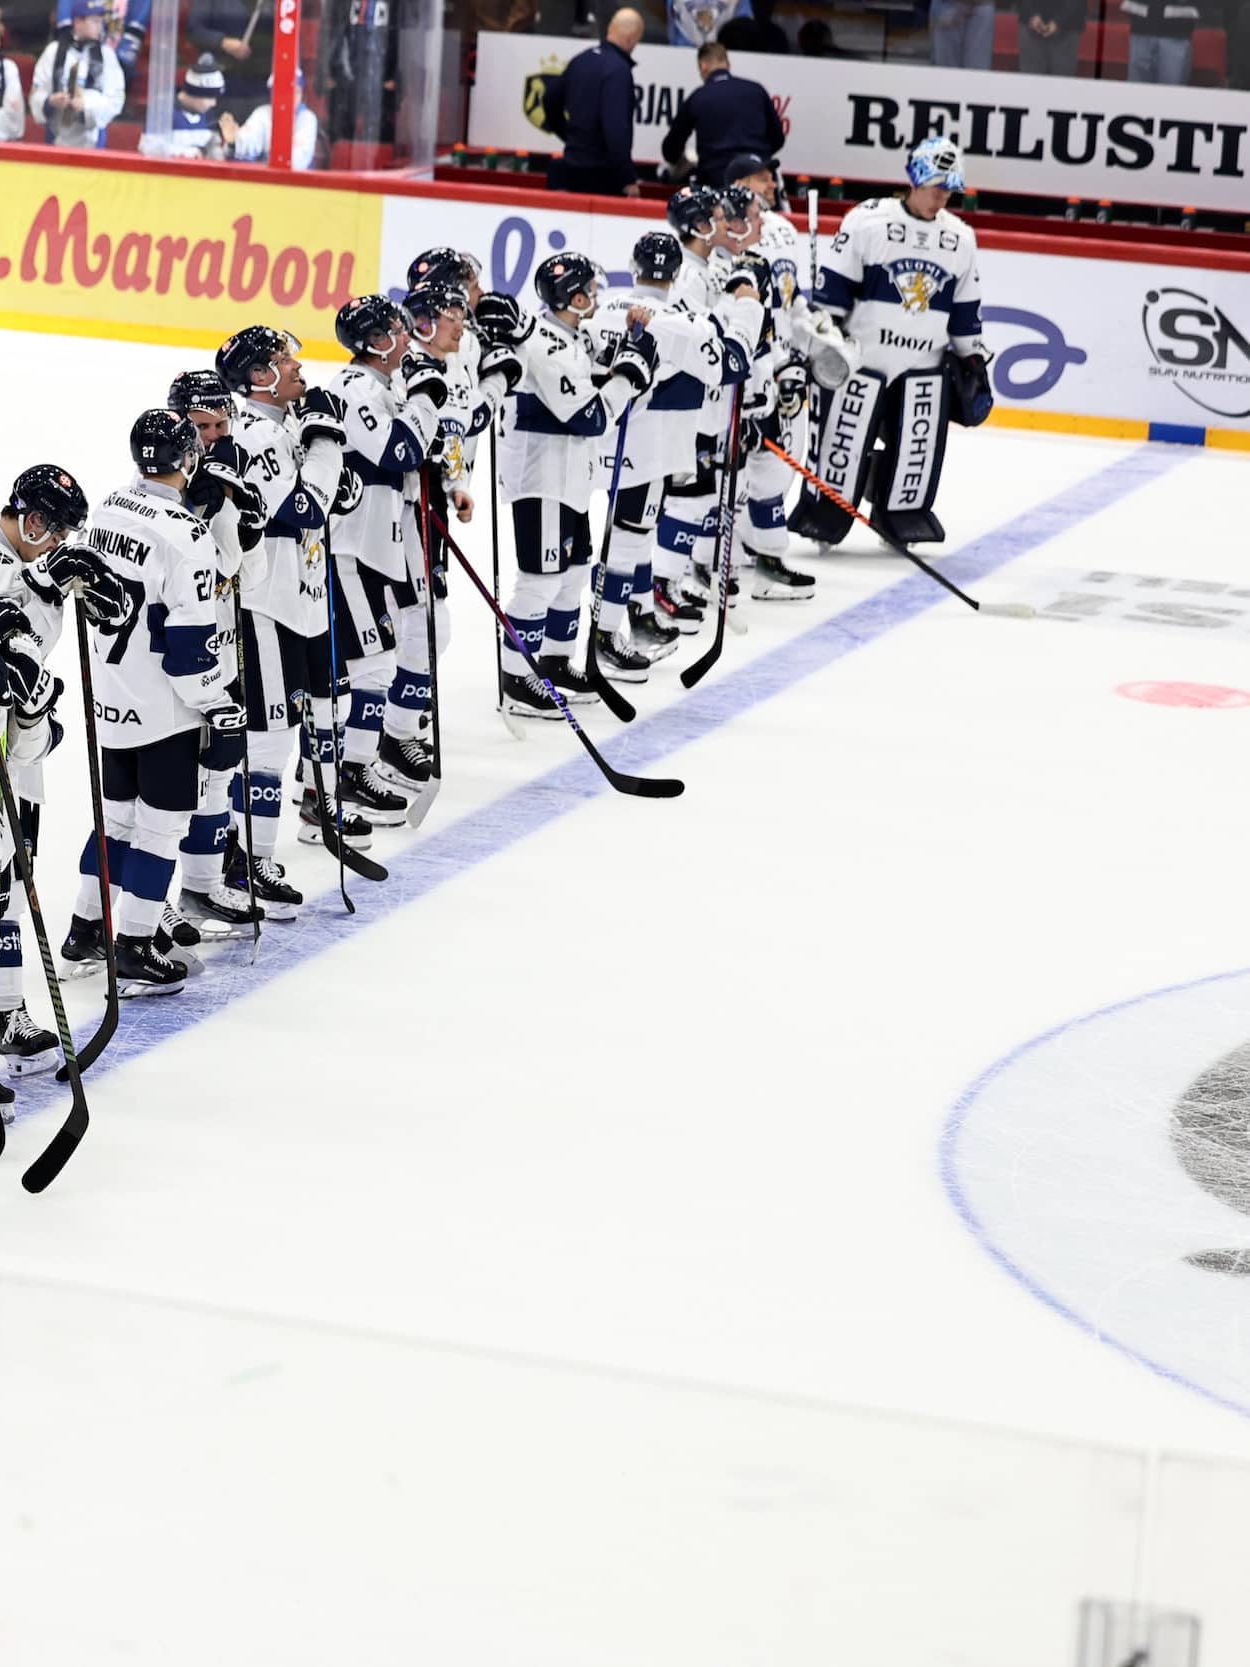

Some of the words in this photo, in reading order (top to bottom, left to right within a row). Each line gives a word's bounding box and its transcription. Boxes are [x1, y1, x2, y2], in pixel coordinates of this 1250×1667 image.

[846, 93, 1247, 178] REILUSTI
[20, 194, 358, 311] Marabou
[654, 252, 667, 266] 37
[896, 261, 941, 278] SUOMI
[560, 375, 577, 397] 4
[358, 405, 378, 432] 6
[142, 446, 155, 459] 27
[898, 381, 933, 505] HECHTER
[253, 447, 281, 482] 36
[544, 548, 557, 562] IS
[362, 628, 377, 646] IS
[269, 703, 285, 720] IS
